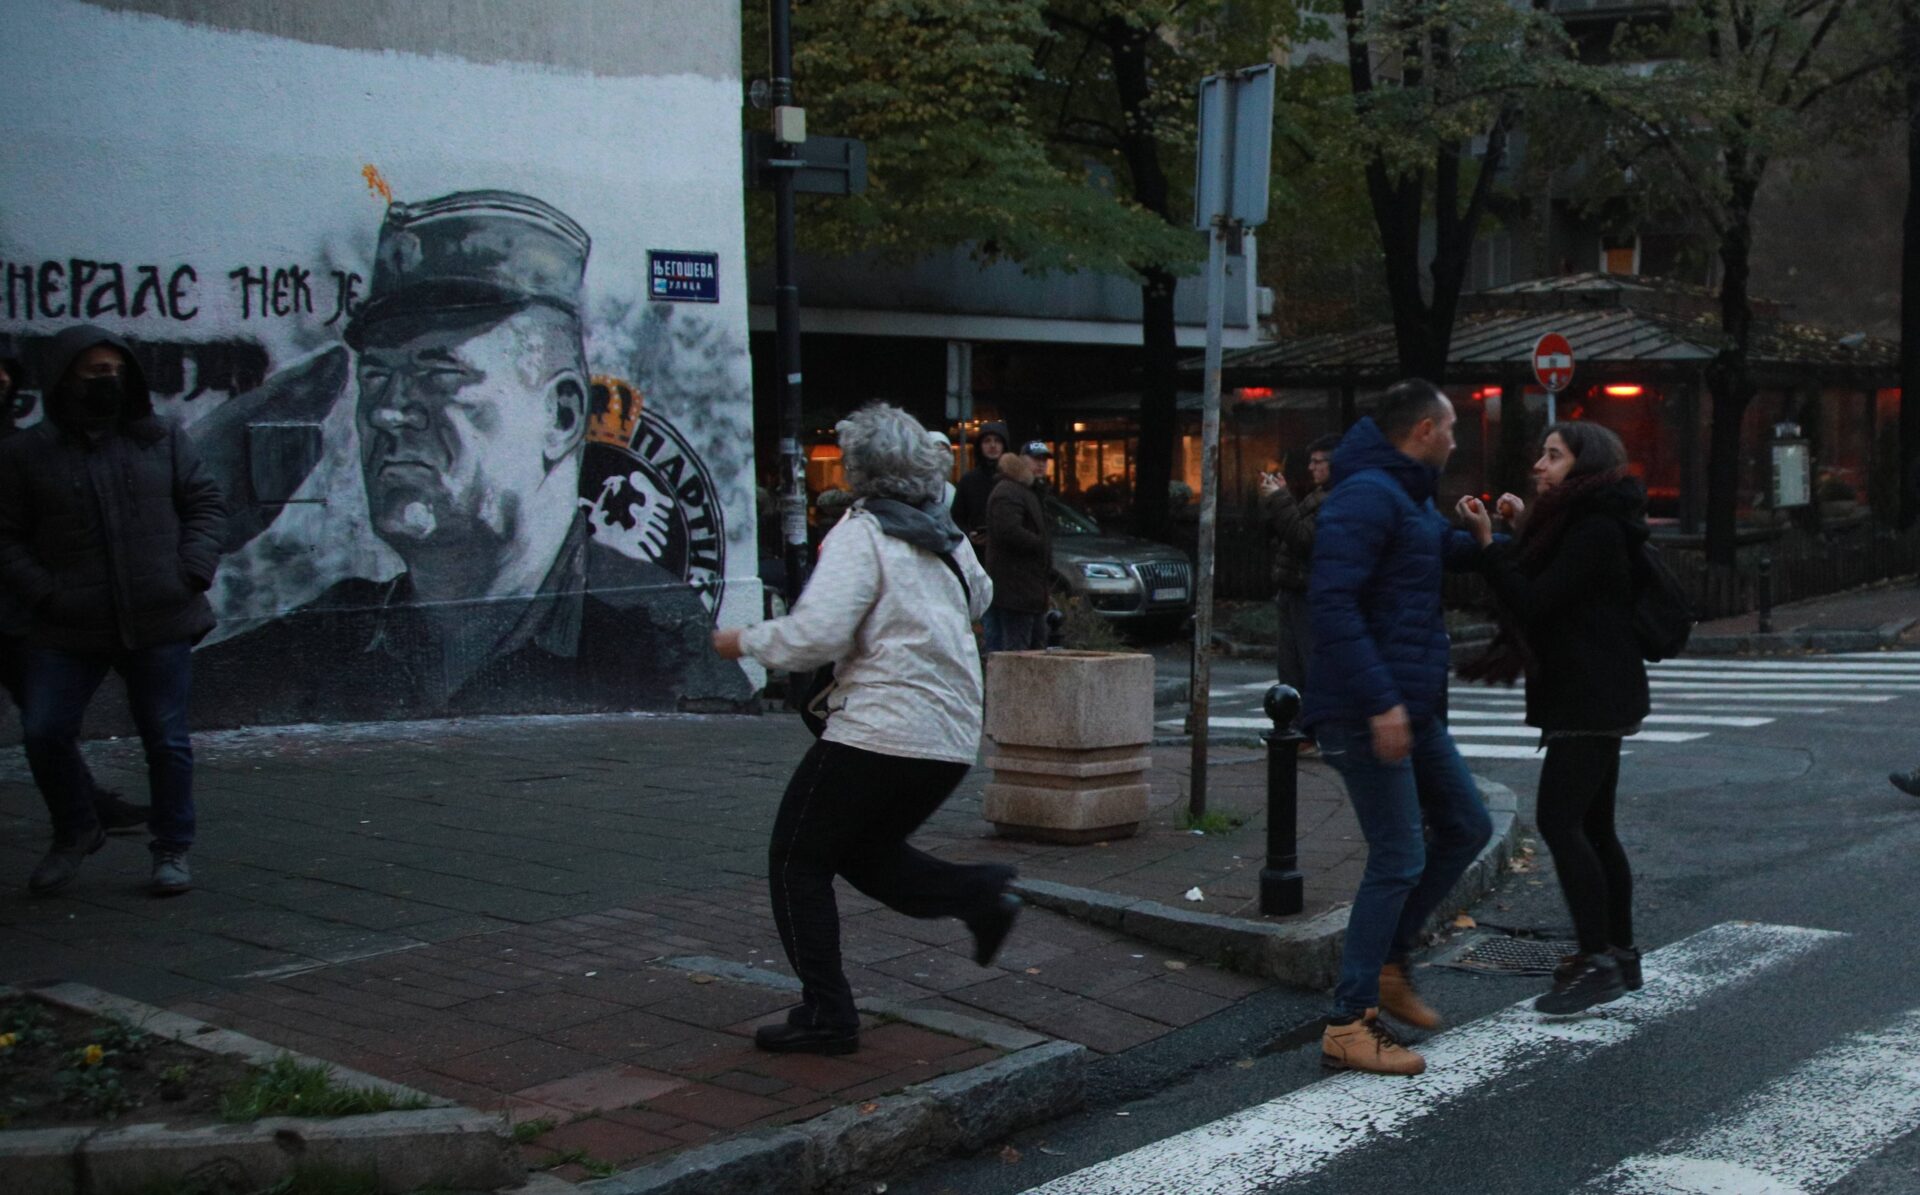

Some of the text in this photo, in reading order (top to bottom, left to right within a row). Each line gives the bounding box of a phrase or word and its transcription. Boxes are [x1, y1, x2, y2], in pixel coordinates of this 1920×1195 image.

[653, 260, 714, 278] ЊЕГОШЕВА
[0, 258, 198, 321] НЕРАЛЕ
[669, 281, 702, 291] УЛИЦА
